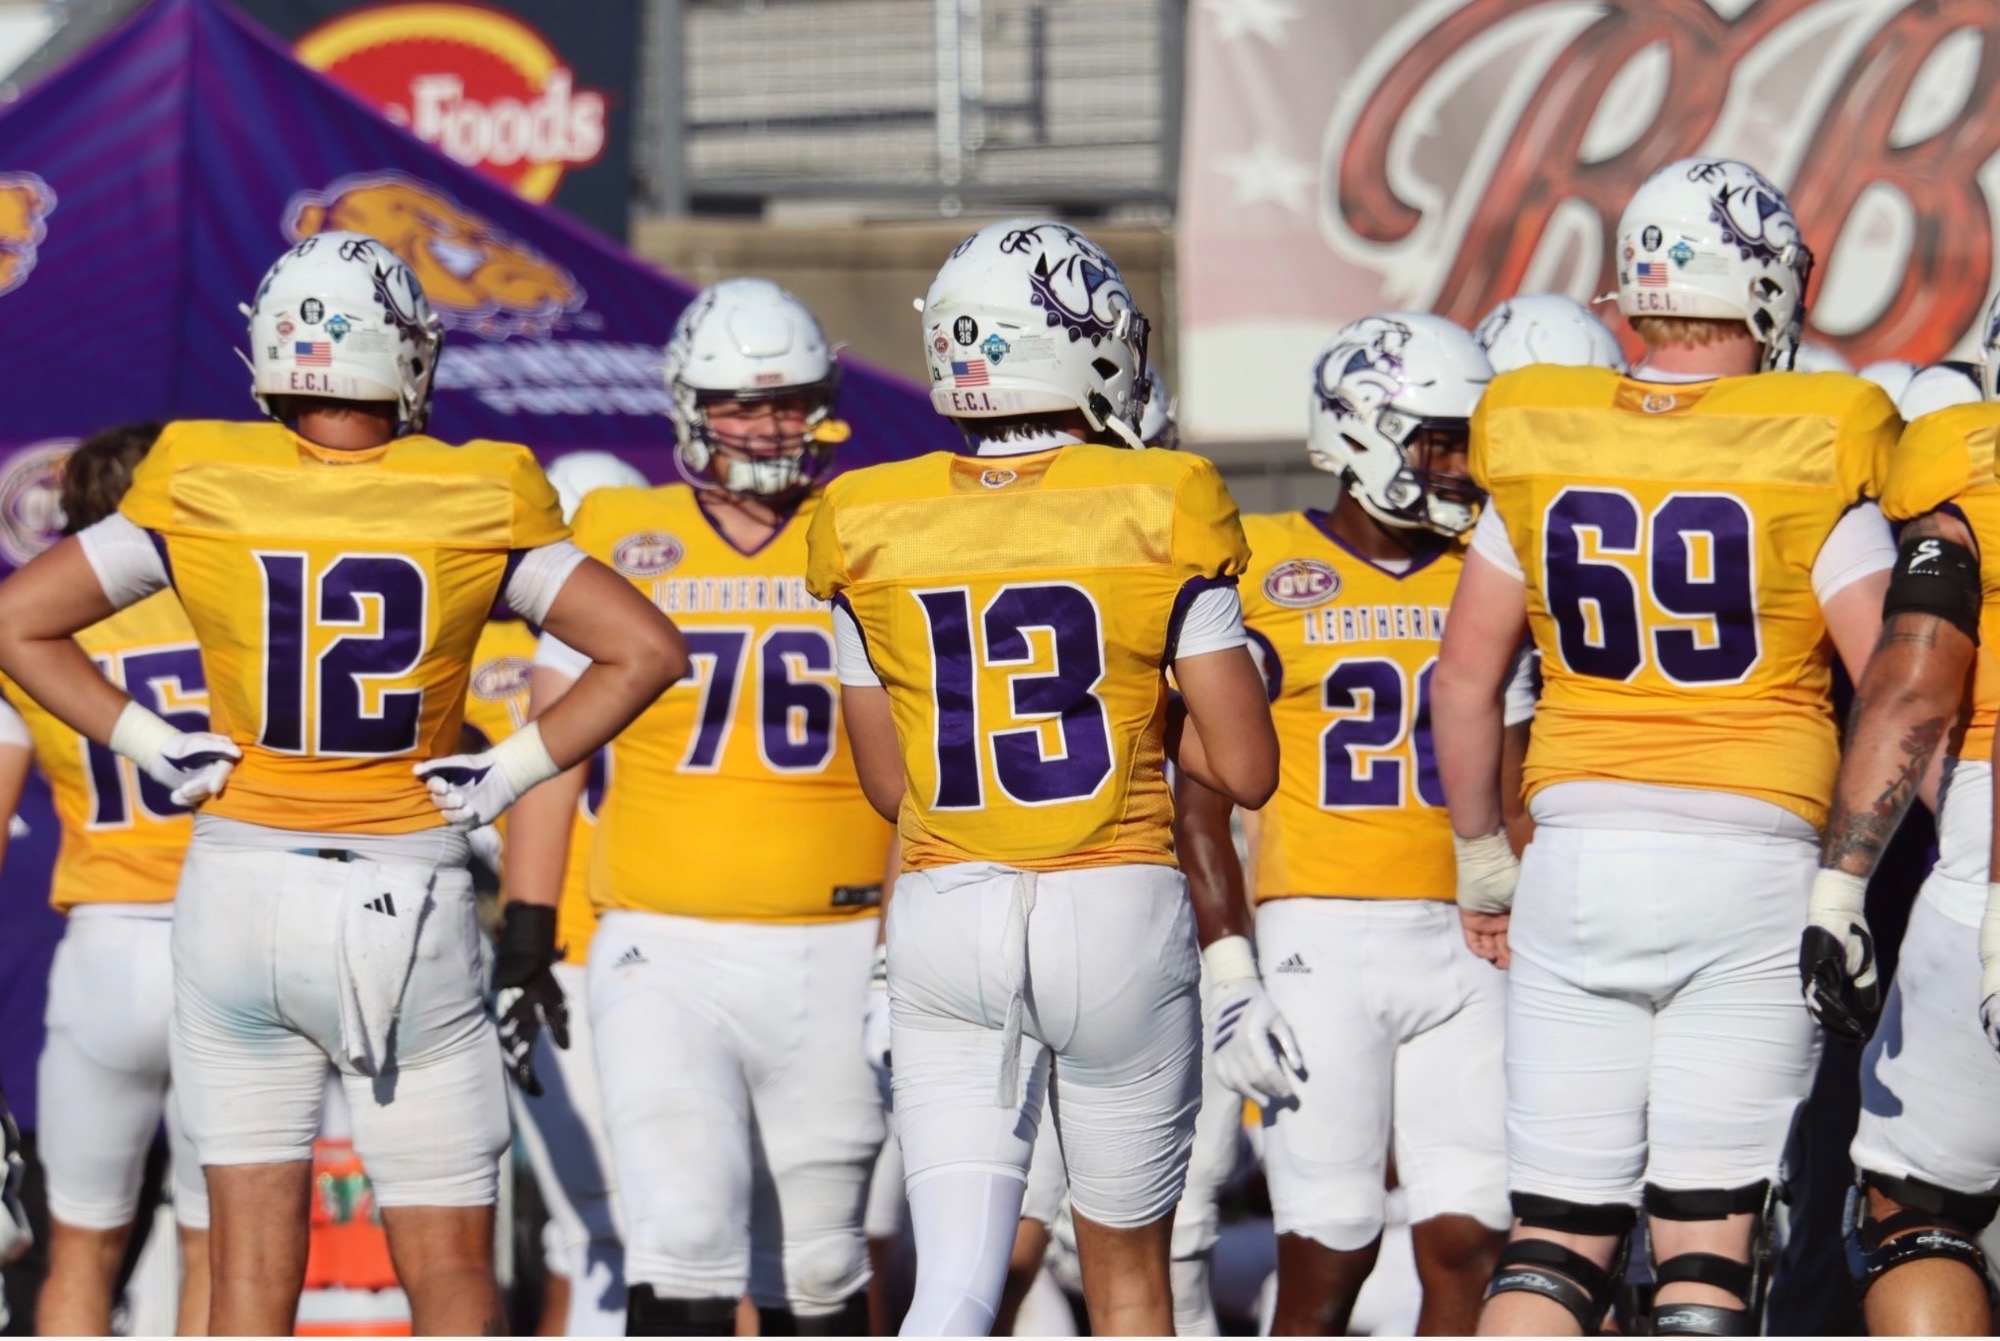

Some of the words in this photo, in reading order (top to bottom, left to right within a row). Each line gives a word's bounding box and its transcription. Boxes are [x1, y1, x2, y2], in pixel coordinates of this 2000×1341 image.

[409, 67, 606, 167] Foods
[1637, 292, 1677, 312] E.C.I.
[958, 319, 972, 332] HM
[959, 331, 972, 344] 36
[291, 371, 335, 393] E.C.I.
[952, 392, 997, 411] E.C.I.
[1277, 573, 1325, 596] OVC
[1544, 487, 1761, 685] 69
[250, 549, 428, 758] 12
[675, 624, 838, 774] 76
[909, 581, 1115, 812] 13
